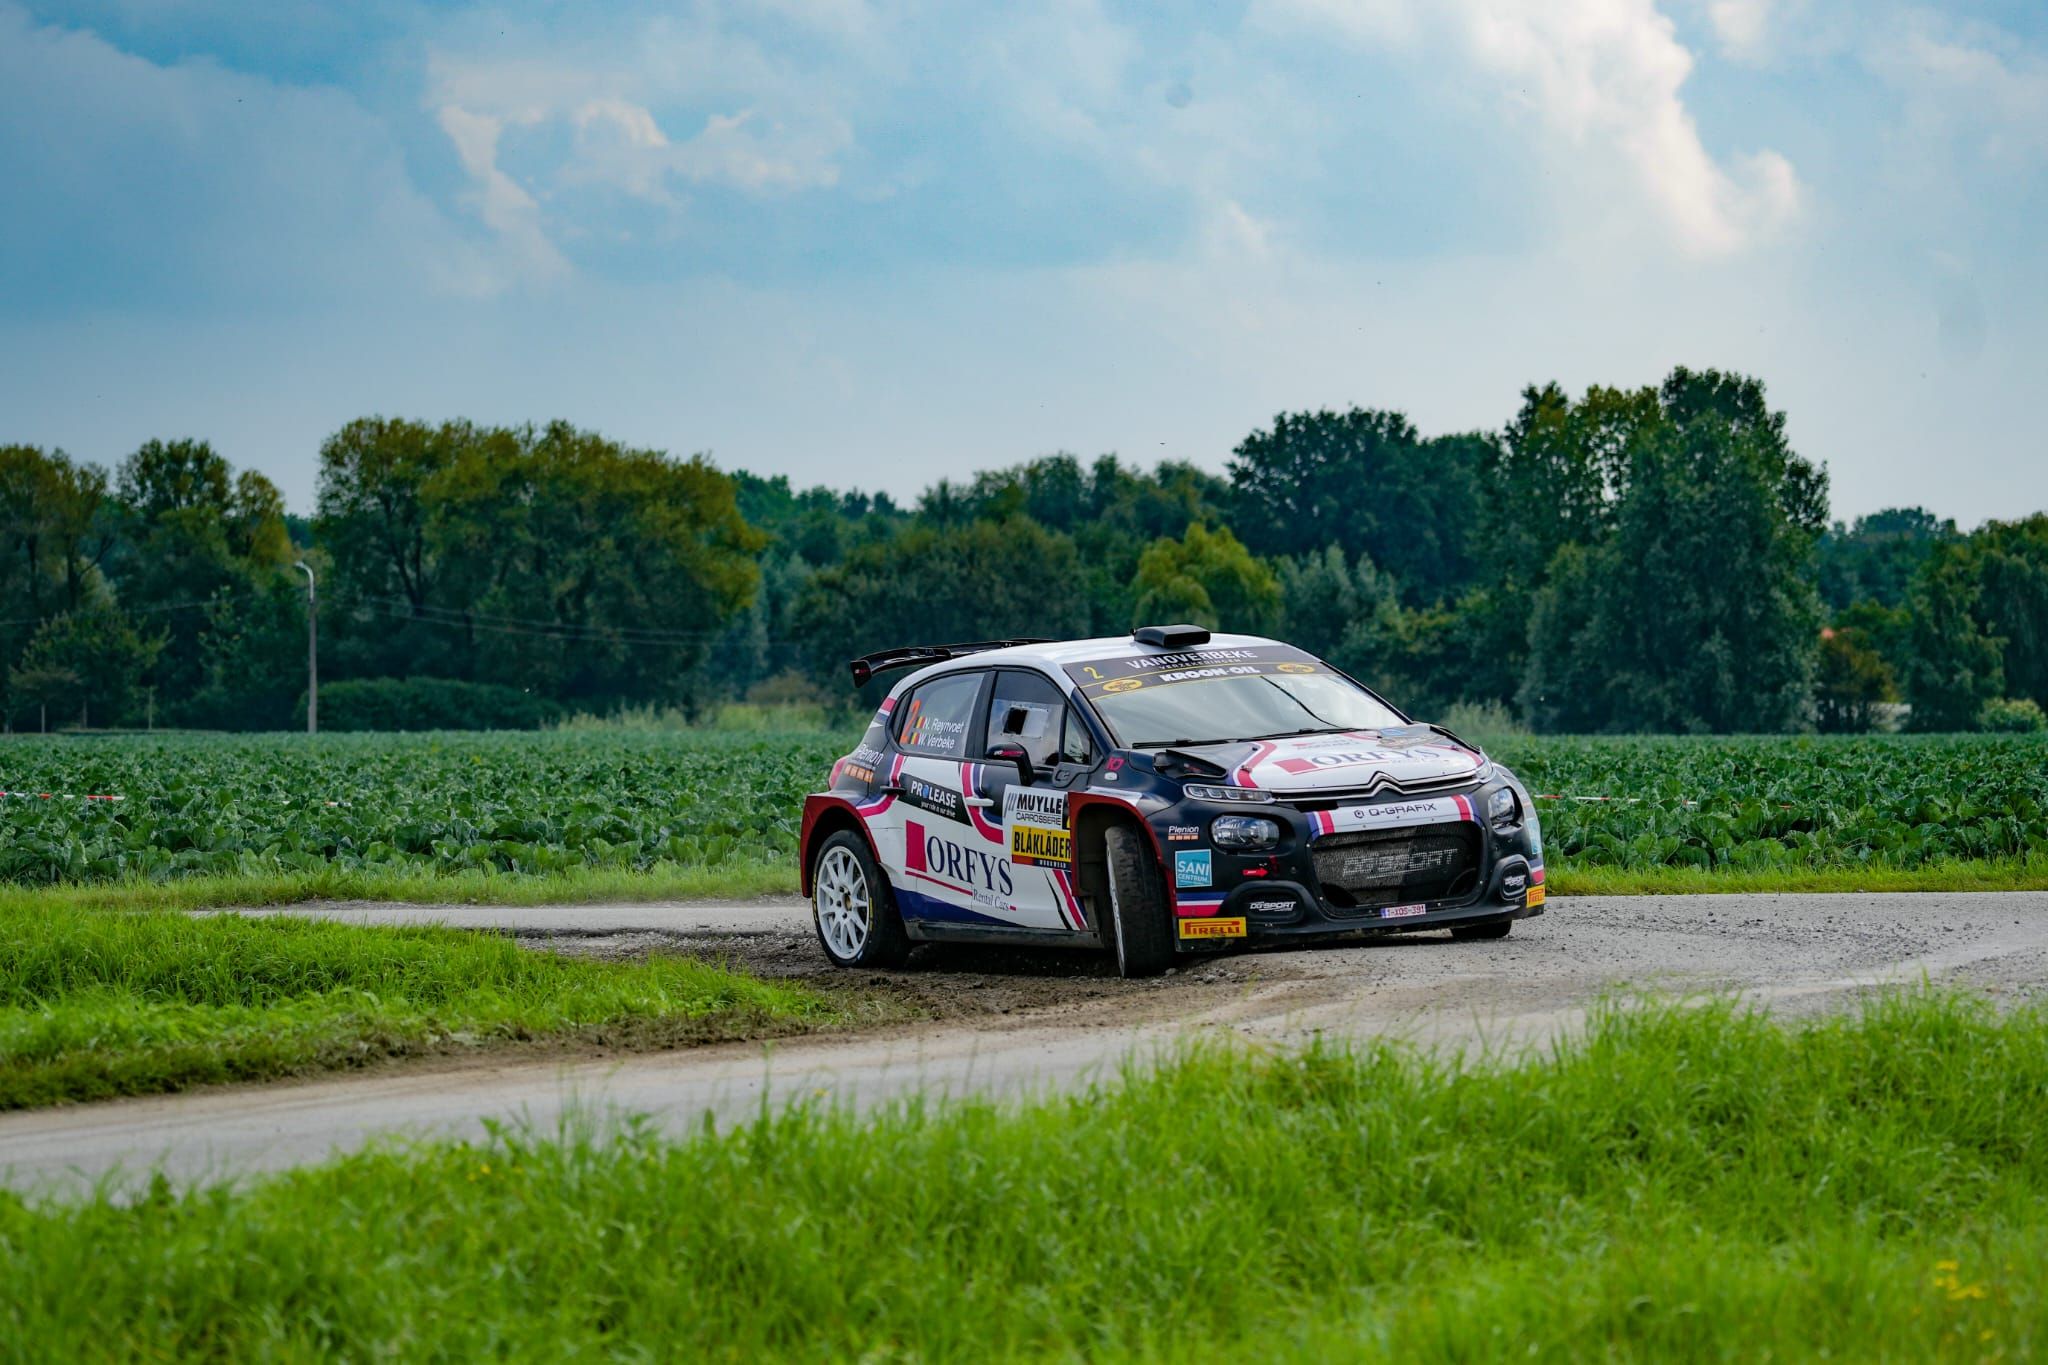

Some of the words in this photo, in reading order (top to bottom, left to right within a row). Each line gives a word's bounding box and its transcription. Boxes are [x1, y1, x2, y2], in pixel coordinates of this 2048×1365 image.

[1126, 650, 1258, 669] VANOVERBEKE
[1083, 666, 1104, 680] 2
[900, 699, 921, 744] 2
[932, 718, 964, 734] Reynvoet
[927, 733, 955, 749] Verbeke
[1312, 750, 1440, 766] ORFYS
[1016, 793, 1063, 814] MUYLLE
[1369, 803, 1437, 816] Q-GRAFIX
[1016, 812, 1062, 826] CARROSSERIE
[1168, 825, 1200, 833] Plenion
[1014, 828, 1071, 859] BLÅKLÄDER
[927, 835, 1013, 896] ORFYS
[1177, 860, 1210, 876] SANI
[1178, 873, 1208, 882] CENTRUM
[973, 888, 994, 906] Rental
[994, 896, 1009, 911] Cars
[1184, 921, 1240, 936] PIRELLI
